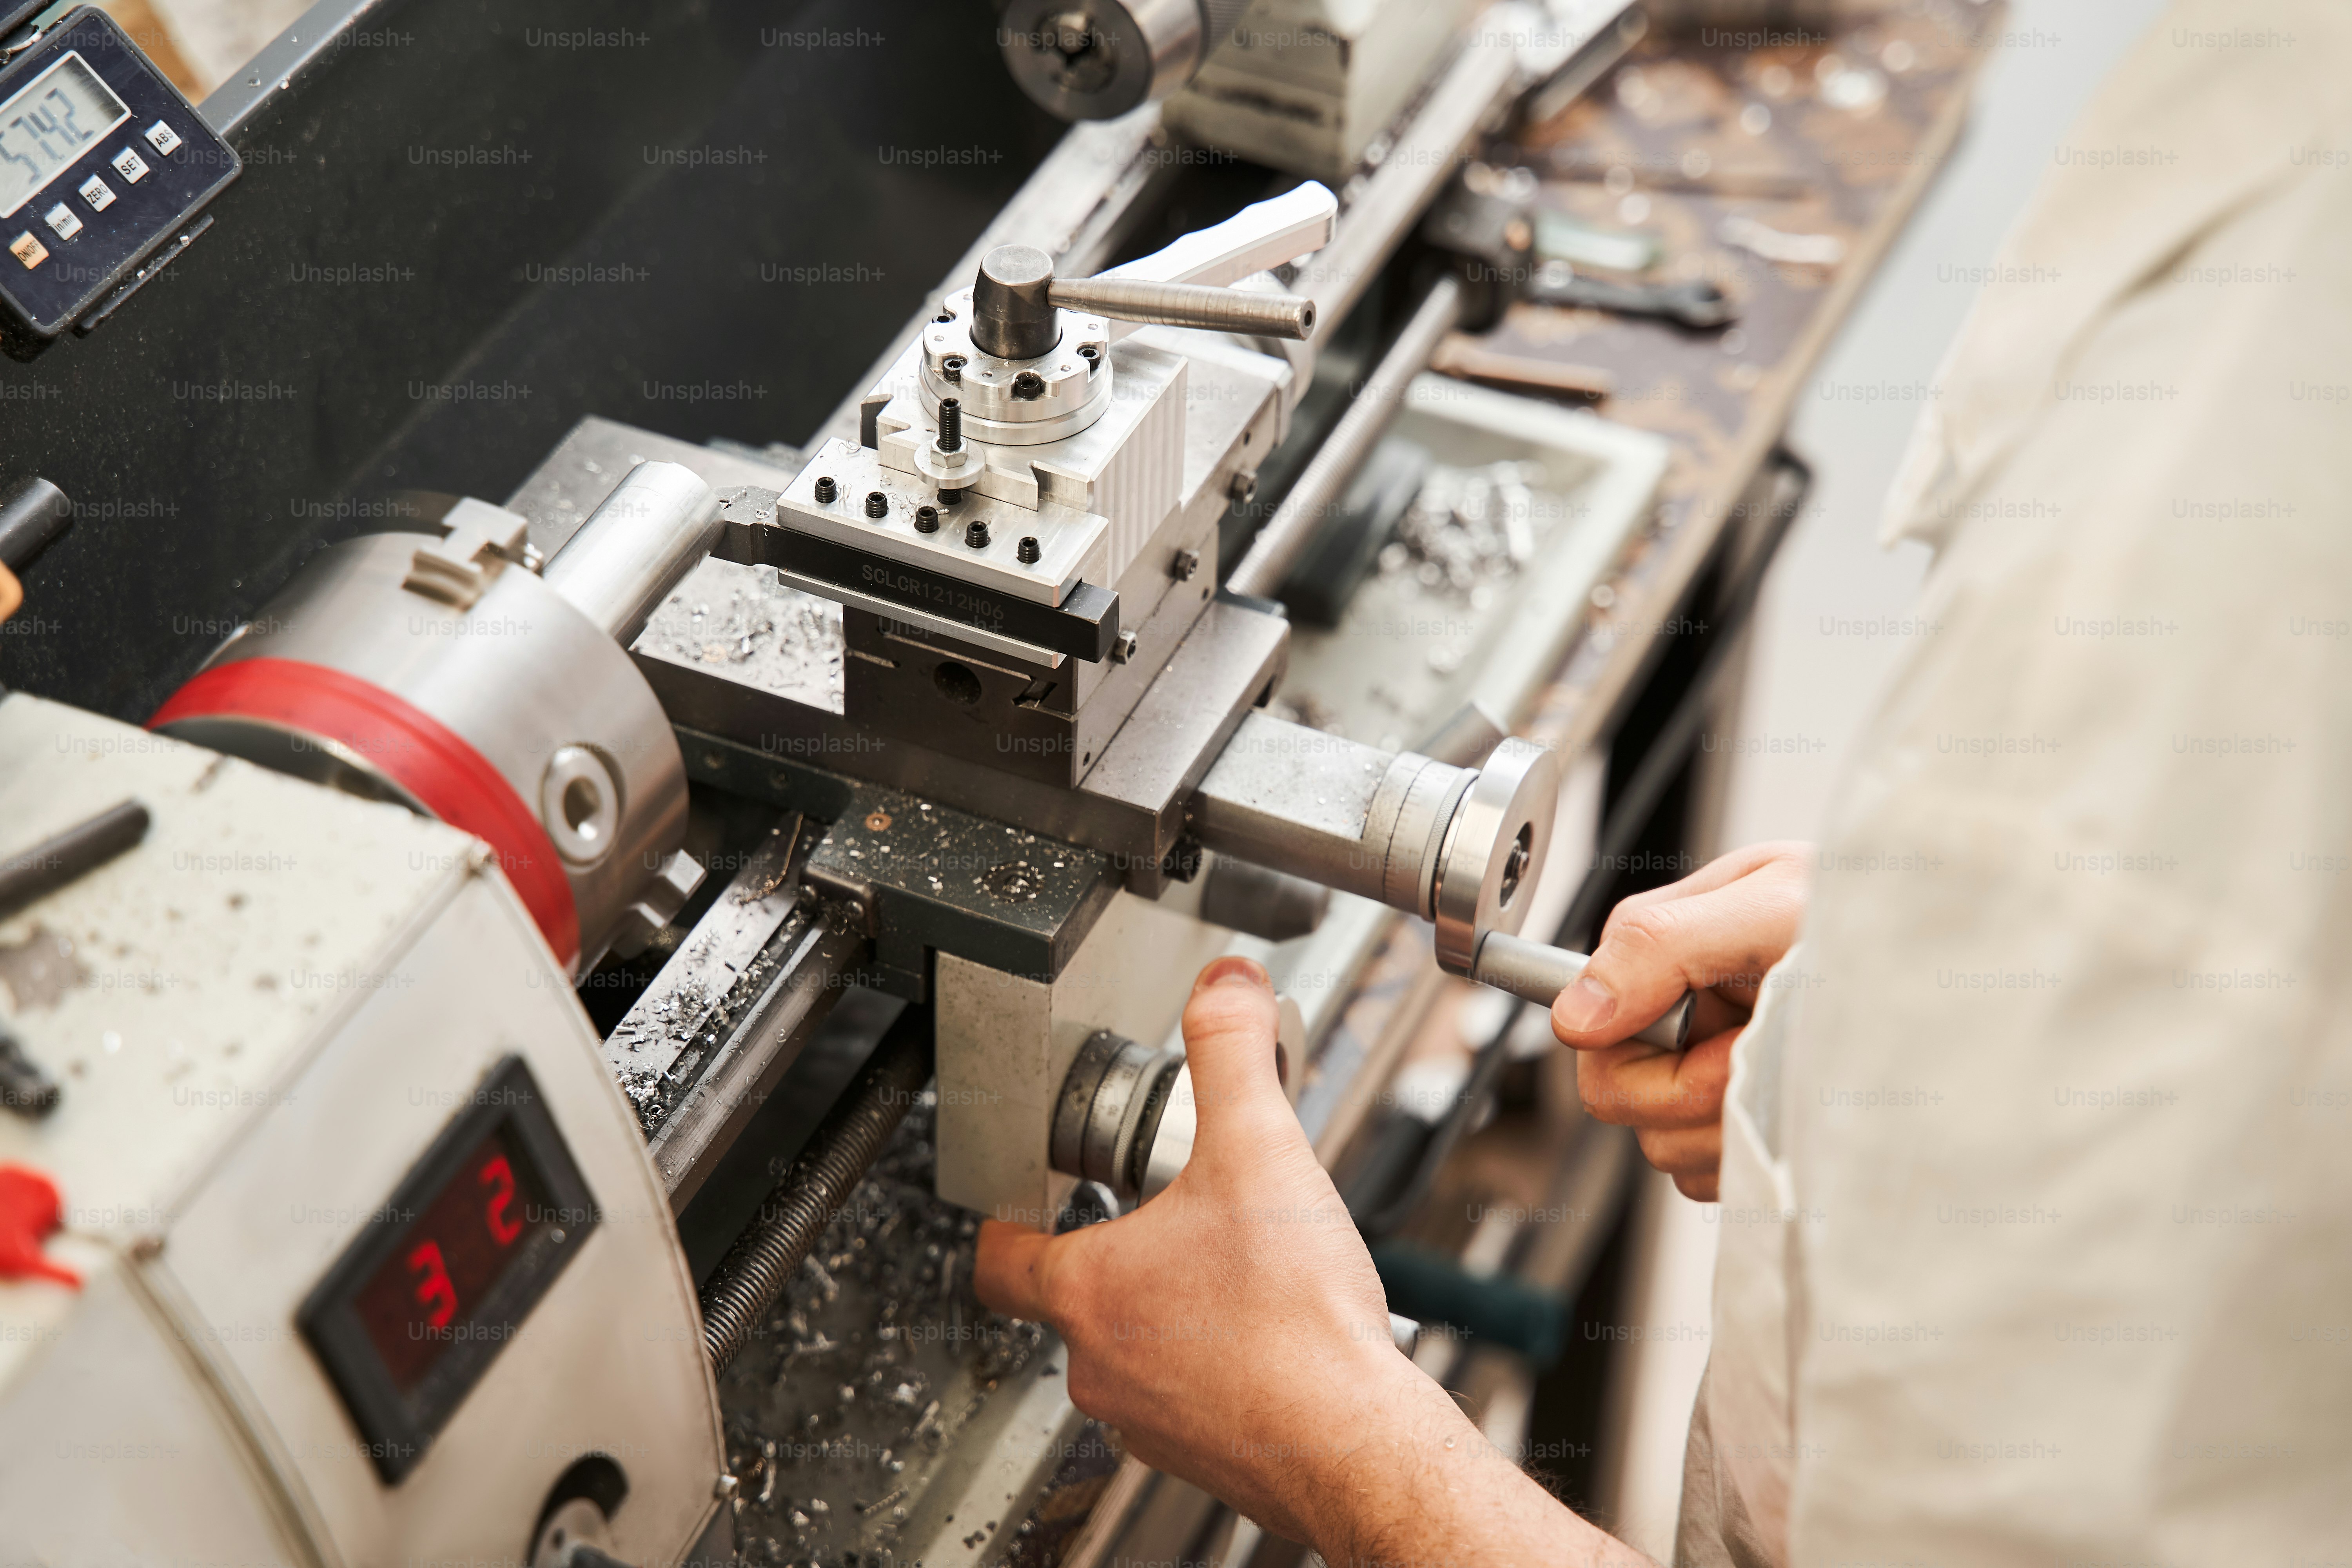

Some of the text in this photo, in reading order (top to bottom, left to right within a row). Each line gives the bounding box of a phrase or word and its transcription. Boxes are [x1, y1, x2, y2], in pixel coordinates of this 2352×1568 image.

[155, 129, 173, 147] ABS
[121, 156, 140, 175] SET
[86, 183, 108, 204] ZERO
[53, 214, 76, 232] in/mm
[17, 240, 41, 262] ON/OFF
[862, 564, 1004, 620] SCLCR1212H06
